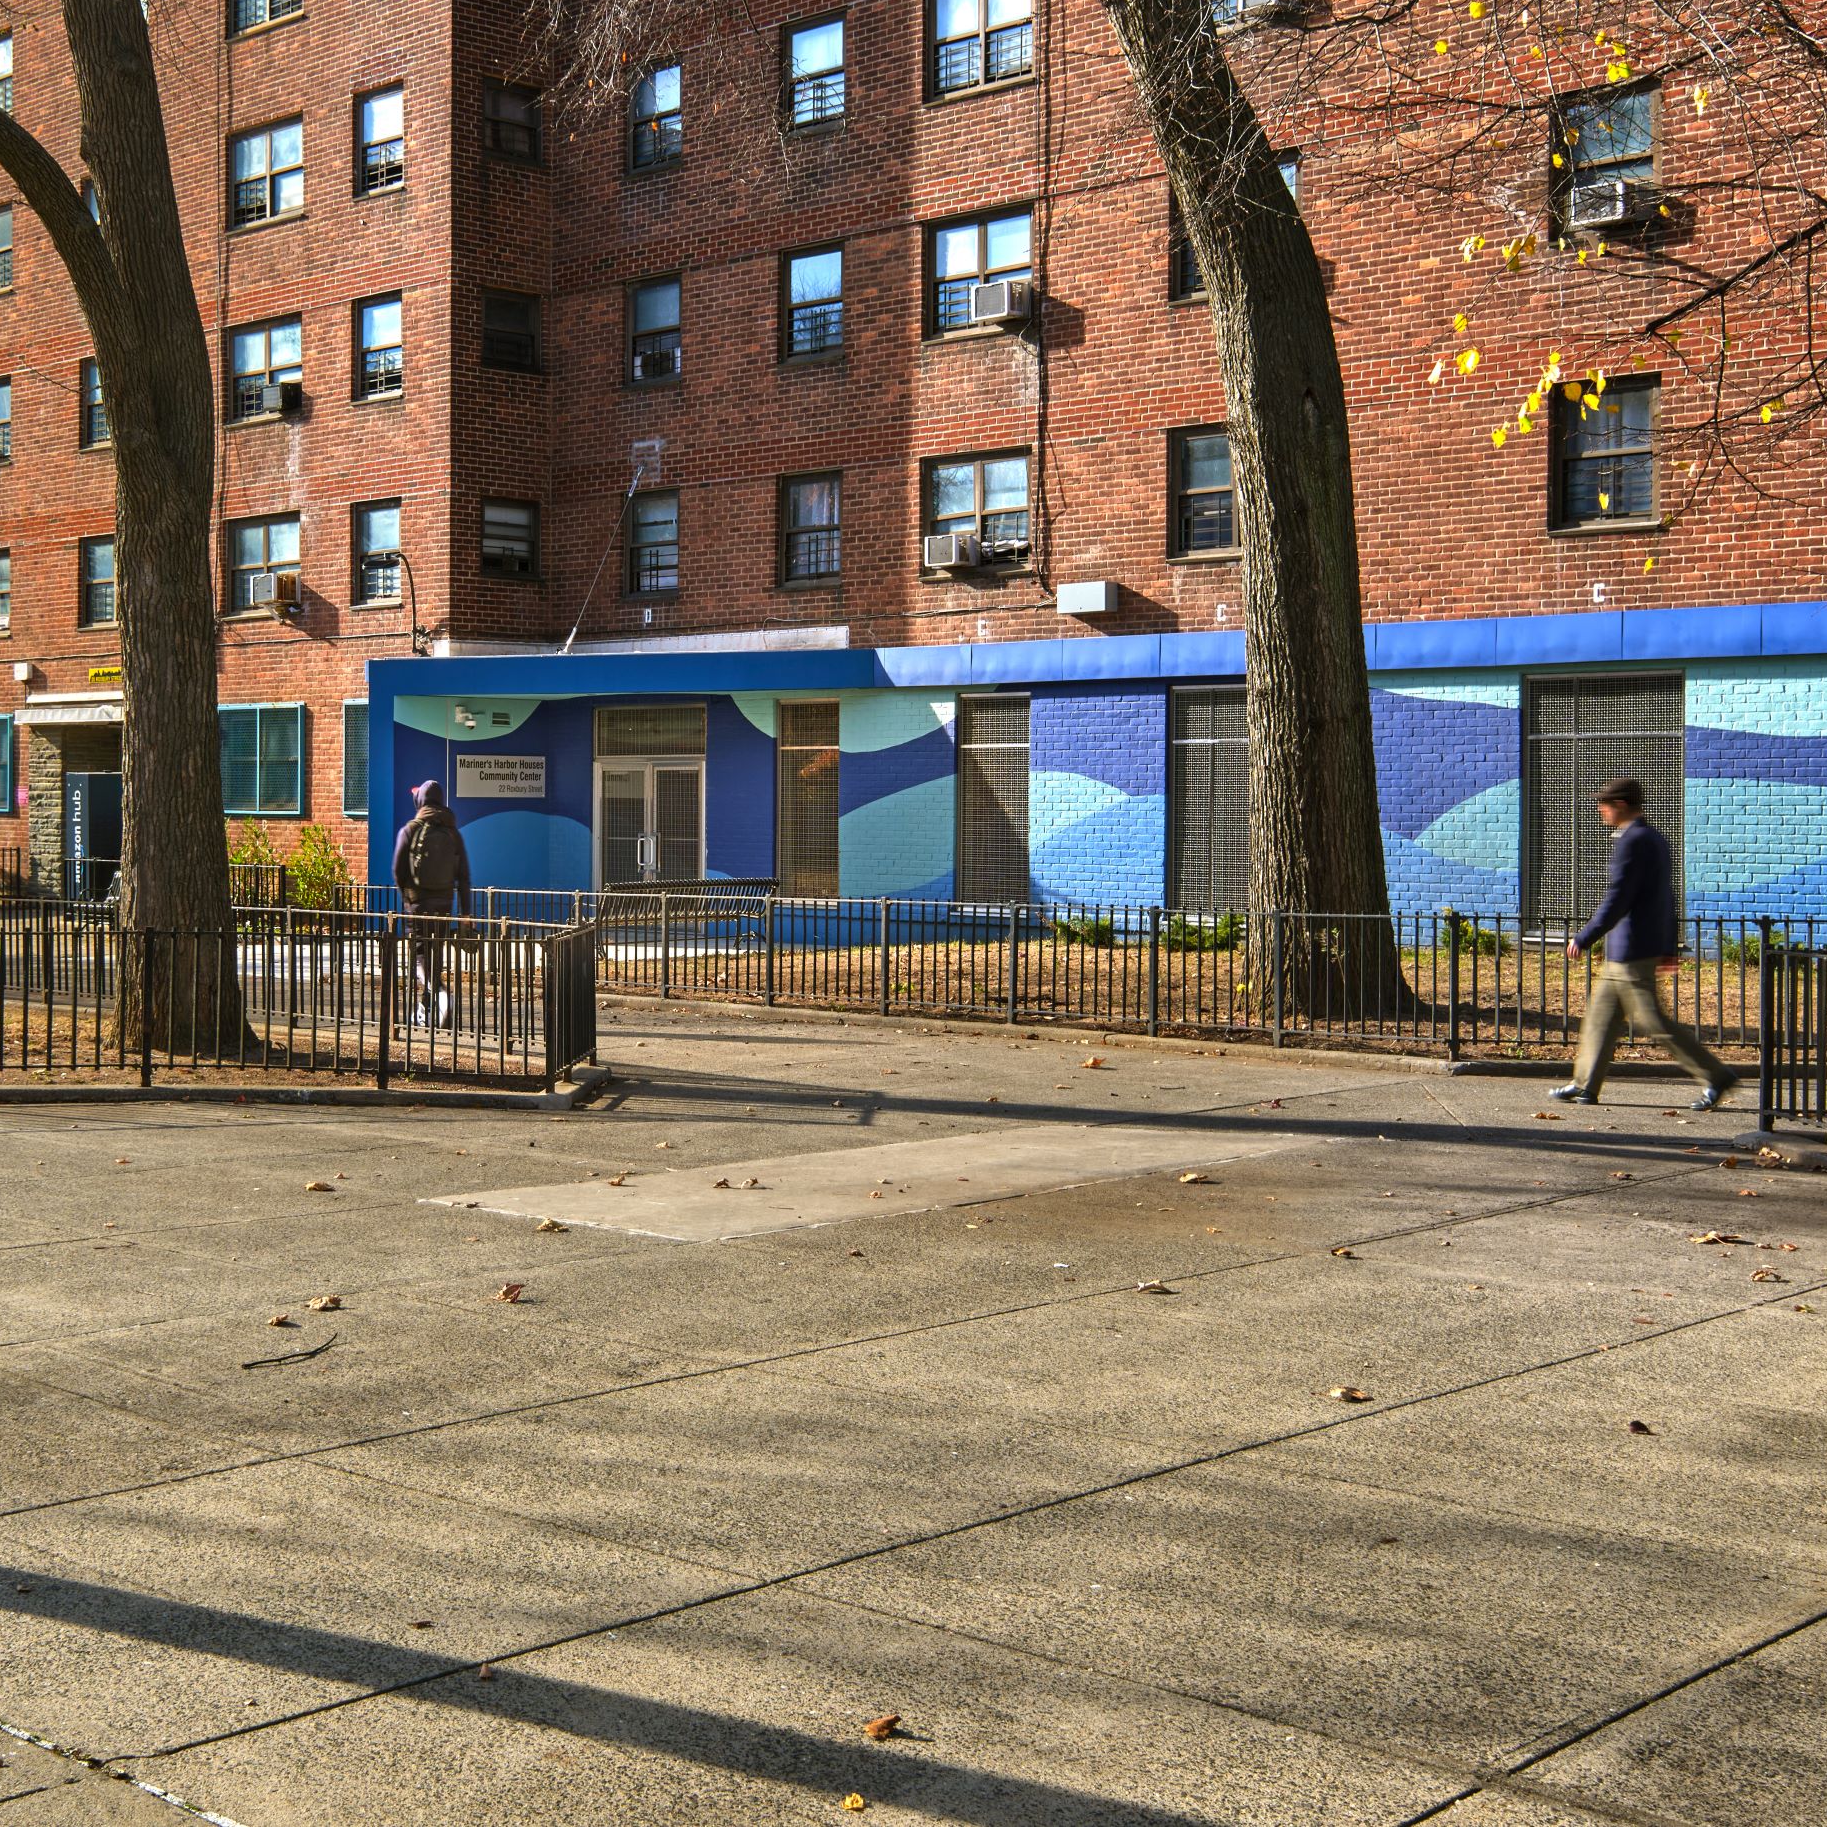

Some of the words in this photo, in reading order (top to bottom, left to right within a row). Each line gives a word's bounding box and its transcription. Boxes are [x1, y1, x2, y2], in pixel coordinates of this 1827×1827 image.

[1593, 583, 1605, 602] C
[459, 758, 492, 769] Mariner's
[494, 759, 518, 769] Harbor
[519, 759, 544, 770] Houses
[479, 770, 518, 782] Community
[519, 771, 542, 781] Center
[498, 785, 506, 793] 22
[506, 785, 527, 794] Roxbury
[528, 785, 543, 793] Street
[72, 790, 81, 822] hub
